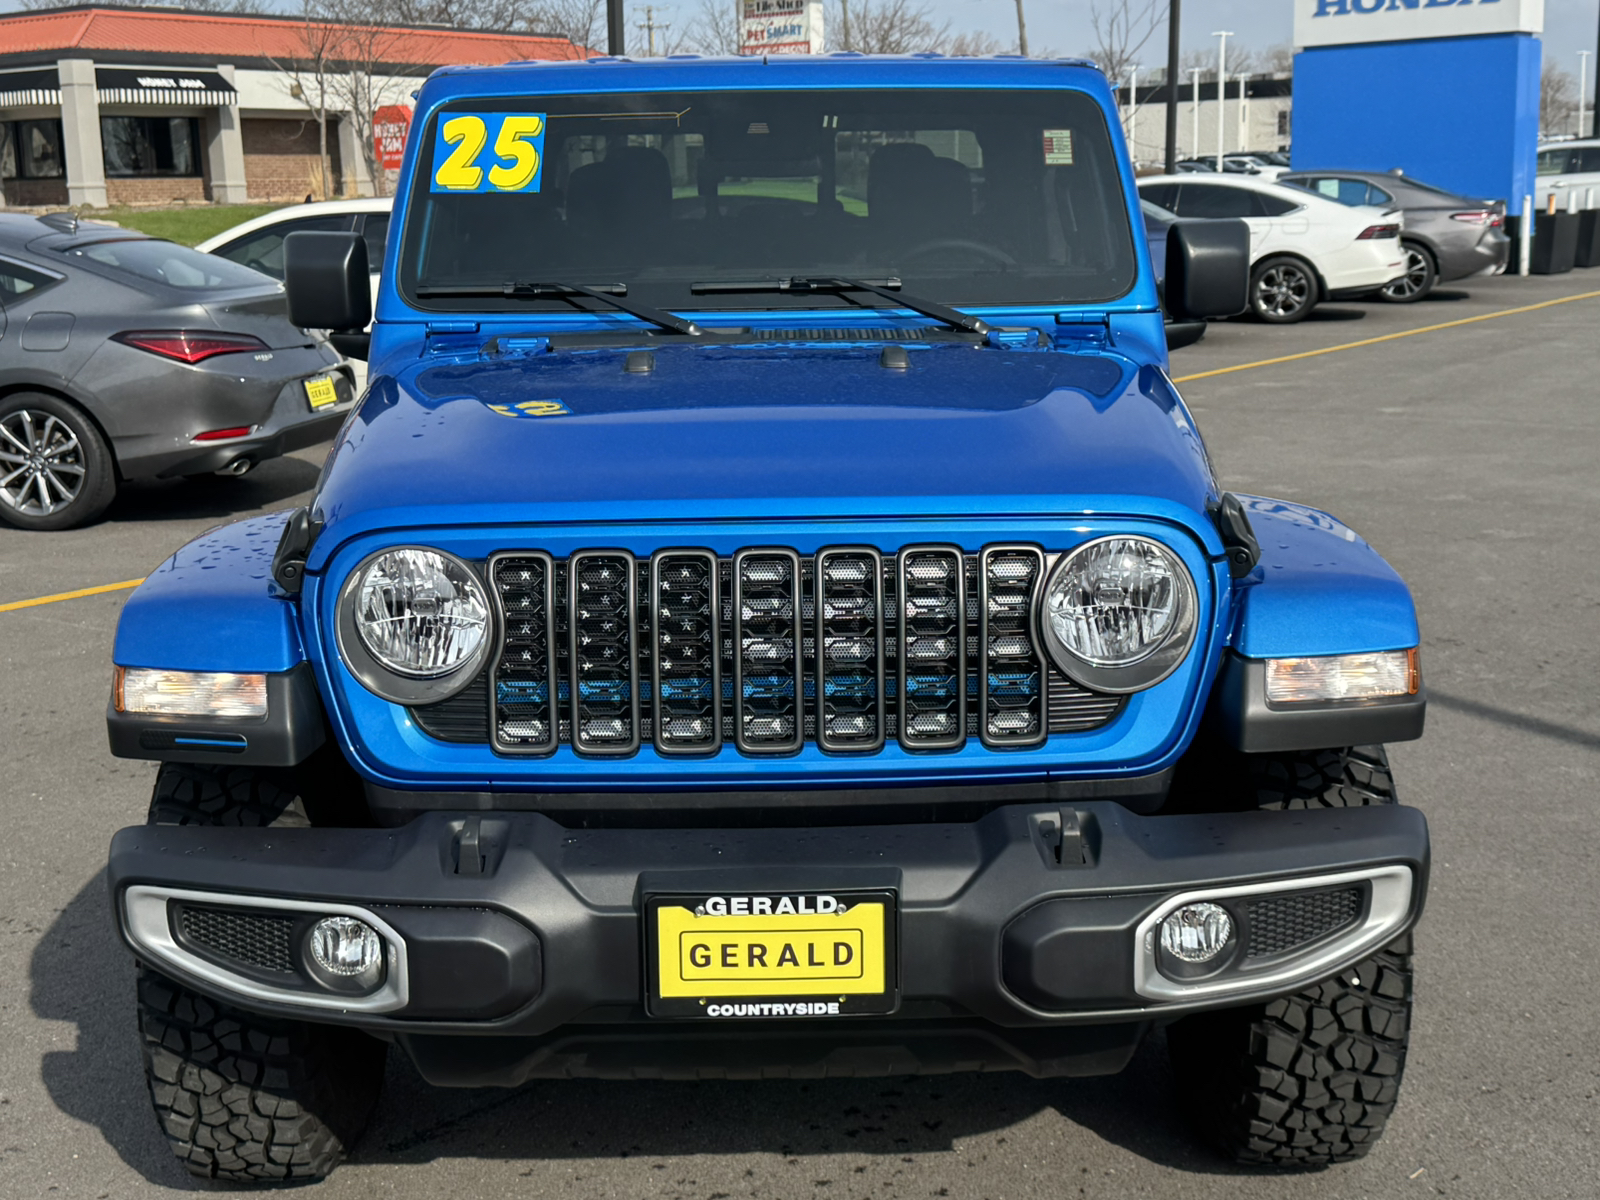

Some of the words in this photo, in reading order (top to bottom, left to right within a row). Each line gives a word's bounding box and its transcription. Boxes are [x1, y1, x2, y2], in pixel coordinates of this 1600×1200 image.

[136, 76, 177, 88] HONEY
[178, 78, 206, 89] JAM
[379, 138, 403, 152] JAM
[435, 115, 543, 191] 25
[705, 895, 838, 916] GERALD
[689, 941, 854, 968] GERALD
[706, 1002, 840, 1017] COUNTRYSIDE
